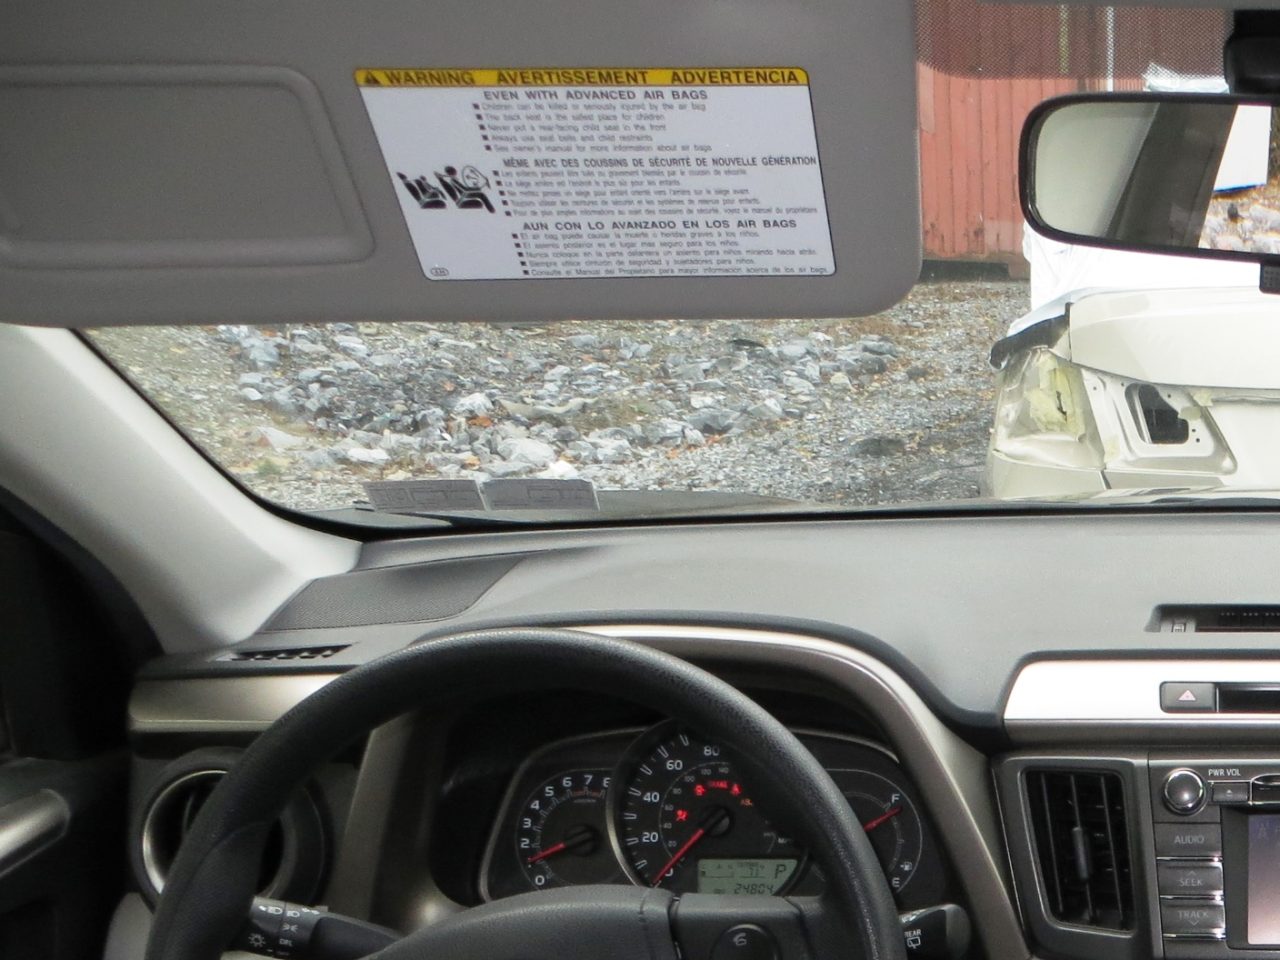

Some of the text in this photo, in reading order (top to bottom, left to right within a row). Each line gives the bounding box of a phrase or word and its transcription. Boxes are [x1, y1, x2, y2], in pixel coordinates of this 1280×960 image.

[384, 70, 799, 84] WARNING AVERTISSEMENT ADVERTENCIA
[484, 91, 707, 100] EVEN WITH ADVANCED AIR BAGS
[503, 155, 816, 168] MÊME AVEC DES COUSSINS DE SÉCURITÉ DE NOUVELLE GÉNÉRATION
[555, 222, 582, 230] CON
[588, 222, 605, 230] LO
[612, 221, 676, 229] AVANZADO
[682, 221, 699, 229] EN
[706, 220, 730, 228] LOS
[737, 220, 756, 228] AIR
[763, 220, 796, 228] BAGS
[704, 745, 720, 756] 80
[666, 759, 683, 770] 60
[1208, 768, 1241, 777] PWR VOL
[562, 777, 573, 788] 6
[584, 774, 593, 785] 7
[545, 786, 555, 797] 5
[643, 792, 660, 802] 40
[892, 793, 900, 804] F
[530, 800, 540, 810] 4
[523, 818, 532, 828] 3
[642, 831, 659, 842] 20
[1174, 836, 1205, 845] AUDIO
[520, 838, 530, 848] 2
[775, 864, 787, 879] P
[535, 875, 545, 886] 0
[892, 877, 900, 888] E
[1179, 878, 1204, 887] SEEK
[734, 883, 774, 895] 24804
[1177, 910, 1209, 919] TRACK
[904, 929, 922, 937] REAR
